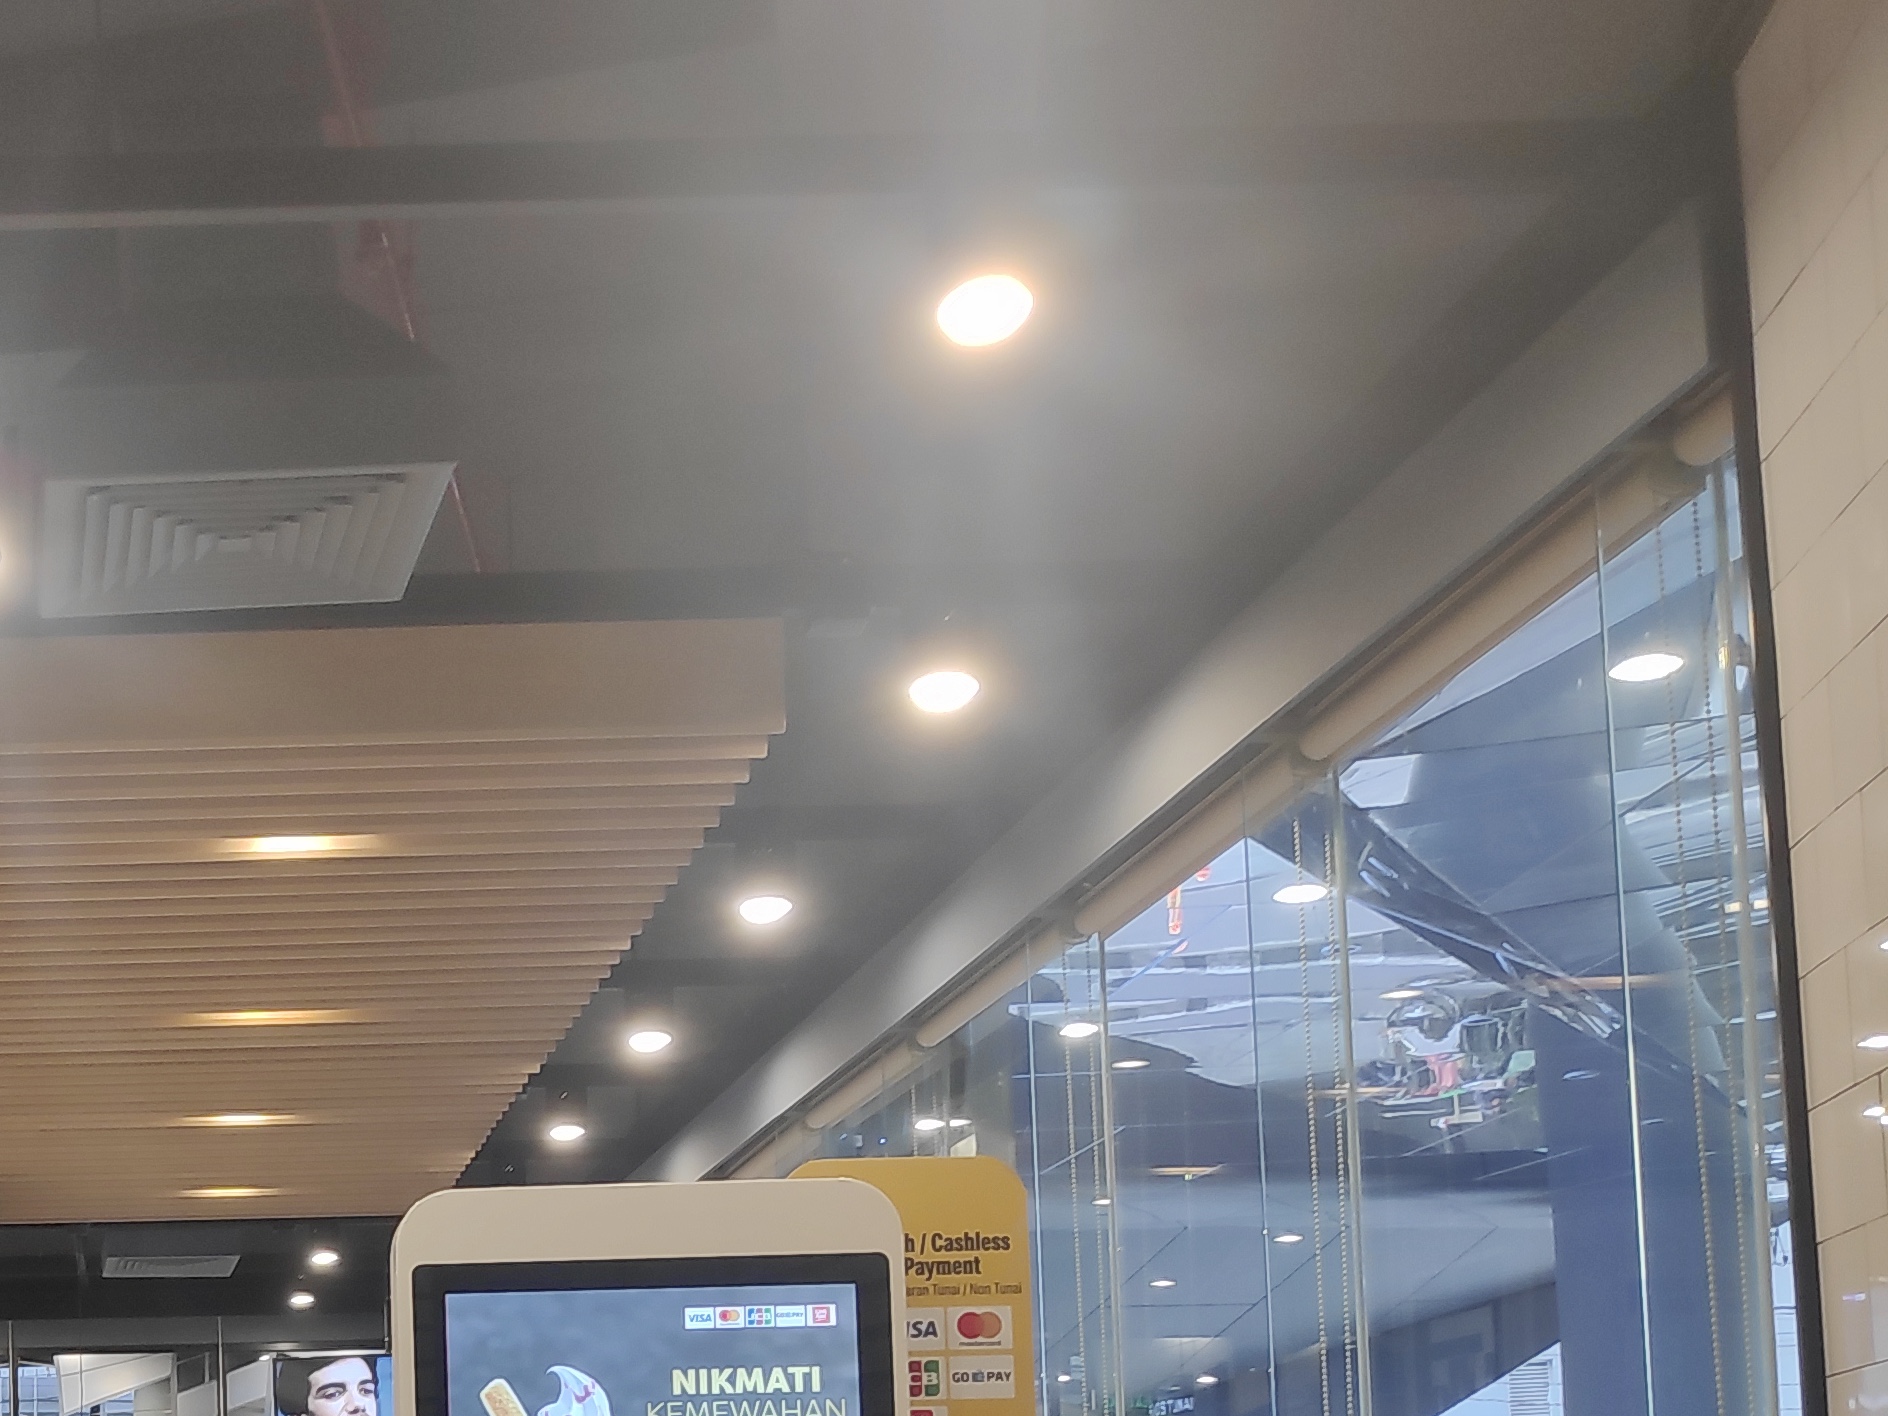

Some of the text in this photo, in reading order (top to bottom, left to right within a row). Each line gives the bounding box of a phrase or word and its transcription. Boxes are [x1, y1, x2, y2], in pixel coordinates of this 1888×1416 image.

[931, 1231, 1011, 1252] Cashless
[904, 1256, 982, 1281] Payment
[969, 1283, 991, 1295] Non
[906, 1320, 939, 1338] ISA
[672, 1366, 821, 1395] NIKMATI
[952, 1371, 1012, 1383] GO PAY
